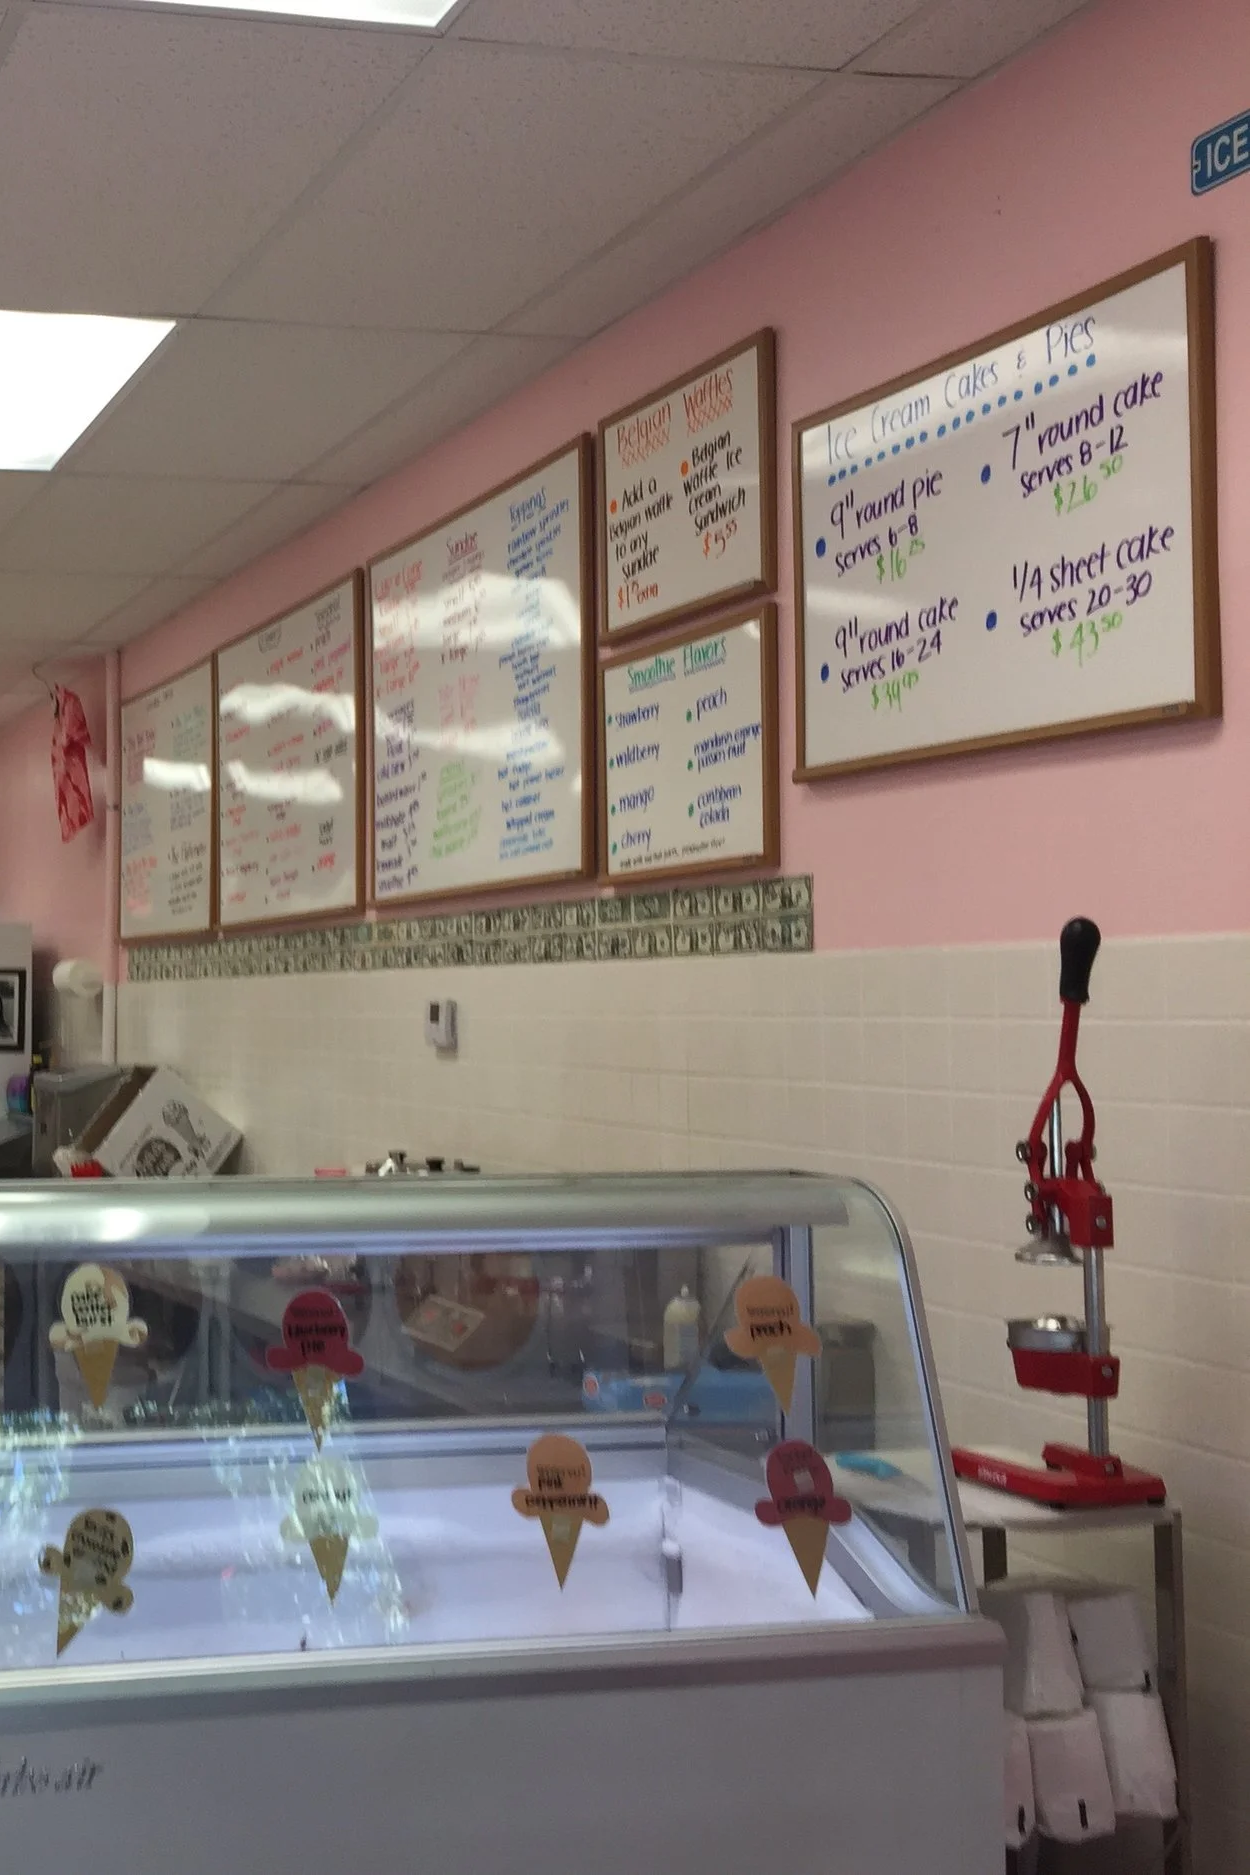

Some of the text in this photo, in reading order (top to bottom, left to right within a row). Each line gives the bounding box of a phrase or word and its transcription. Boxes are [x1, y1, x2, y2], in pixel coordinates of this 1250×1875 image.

[1206, 123, 1249, 179] ICE
[827, 423, 857, 465] Ice
[870, 394, 931, 444] Cream
[944, 360, 999, 409] Cakes
[1045, 315, 1096, 364] Pies
[1038, 392, 1104, 456] round
[1113, 371, 1164, 418] cake
[691, 430, 731, 469] Belgian
[856, 479, 905, 529] round
[912, 467, 943, 511] pie
[1020, 453, 1073, 499] serves
[835, 534, 882, 579] serves
[1013, 524, 1175, 603] 1/4 sheet cake
[859, 611, 910, 655] round
[918, 596, 959, 633] cake
[1020, 597, 1078, 639] serves
[840, 655, 886, 694] serves
[696, 686, 728, 721] peach
[618, 783, 655, 814] mango
